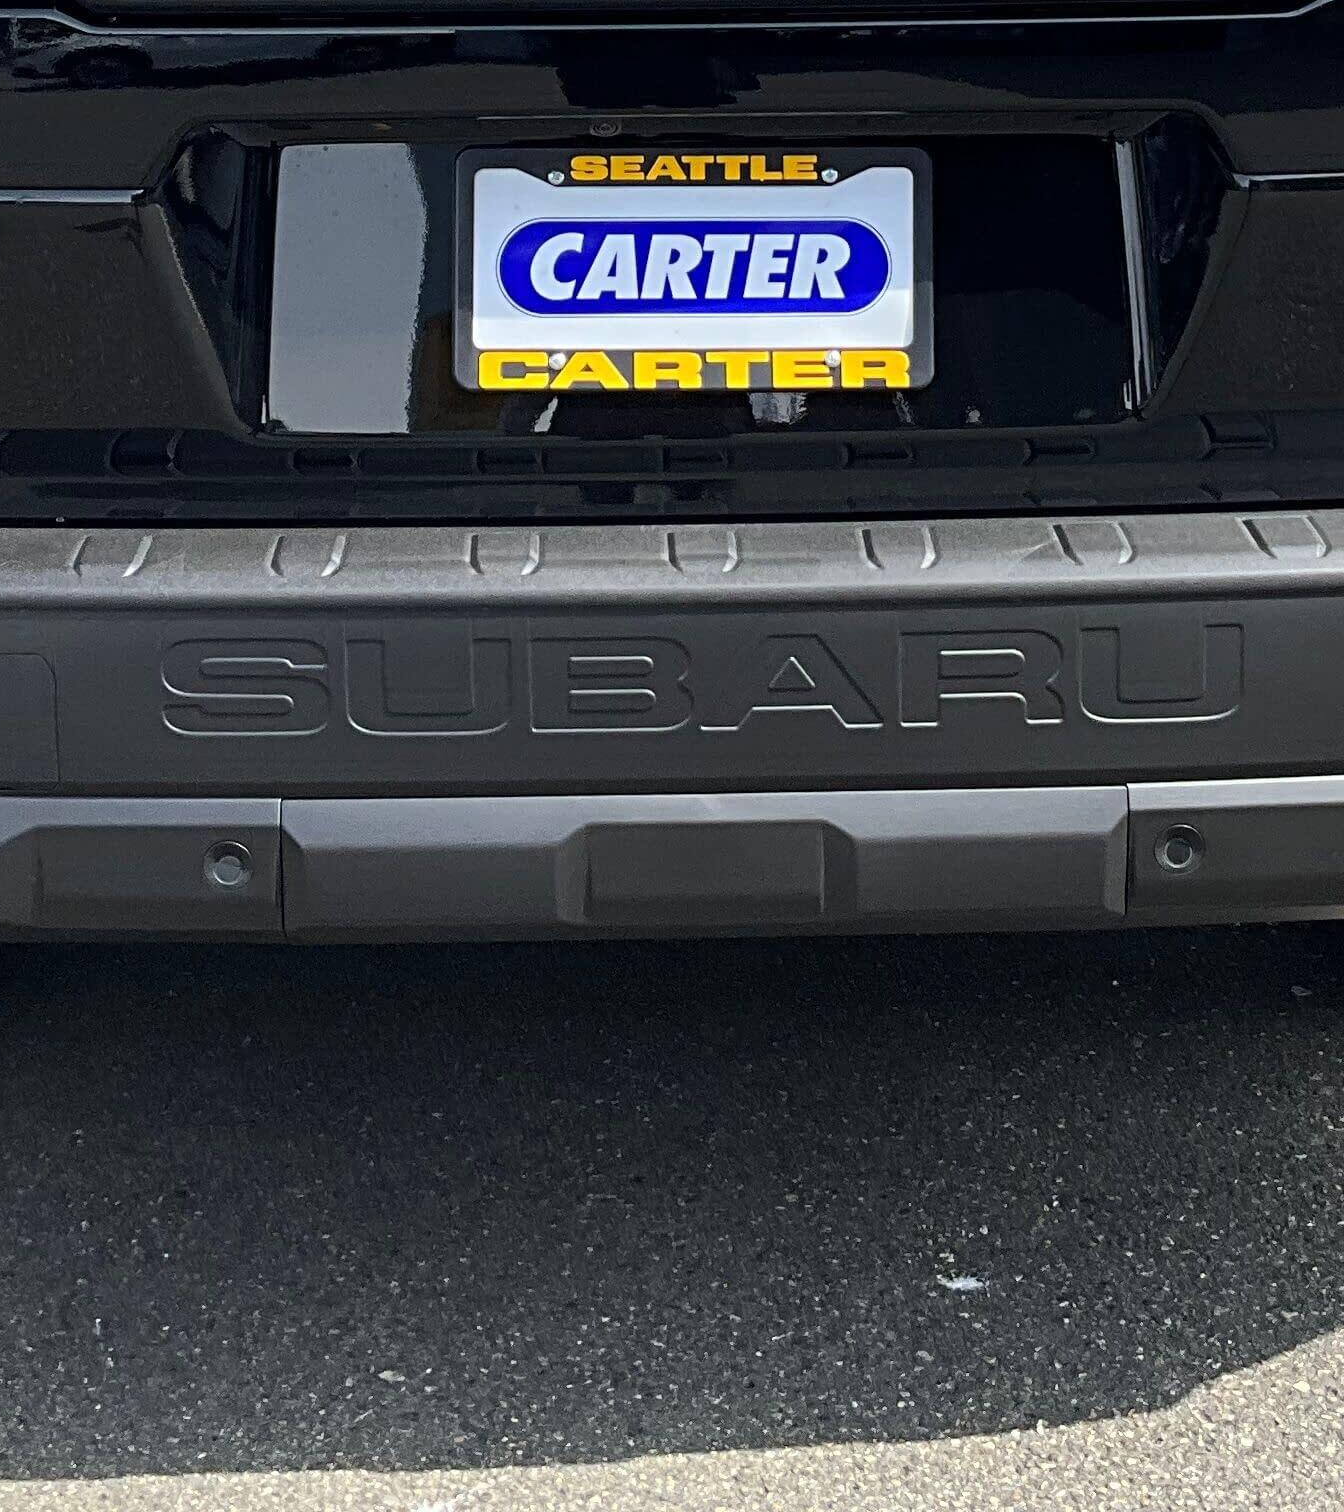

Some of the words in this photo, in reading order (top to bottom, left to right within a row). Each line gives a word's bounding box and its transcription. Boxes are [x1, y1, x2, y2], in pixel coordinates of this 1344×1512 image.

[570, 154, 818, 181] SEATTLE
[529, 233, 851, 300] CARTER
[477, 350, 911, 389] CARTER
[161, 621, 1245, 737] SUBARU
